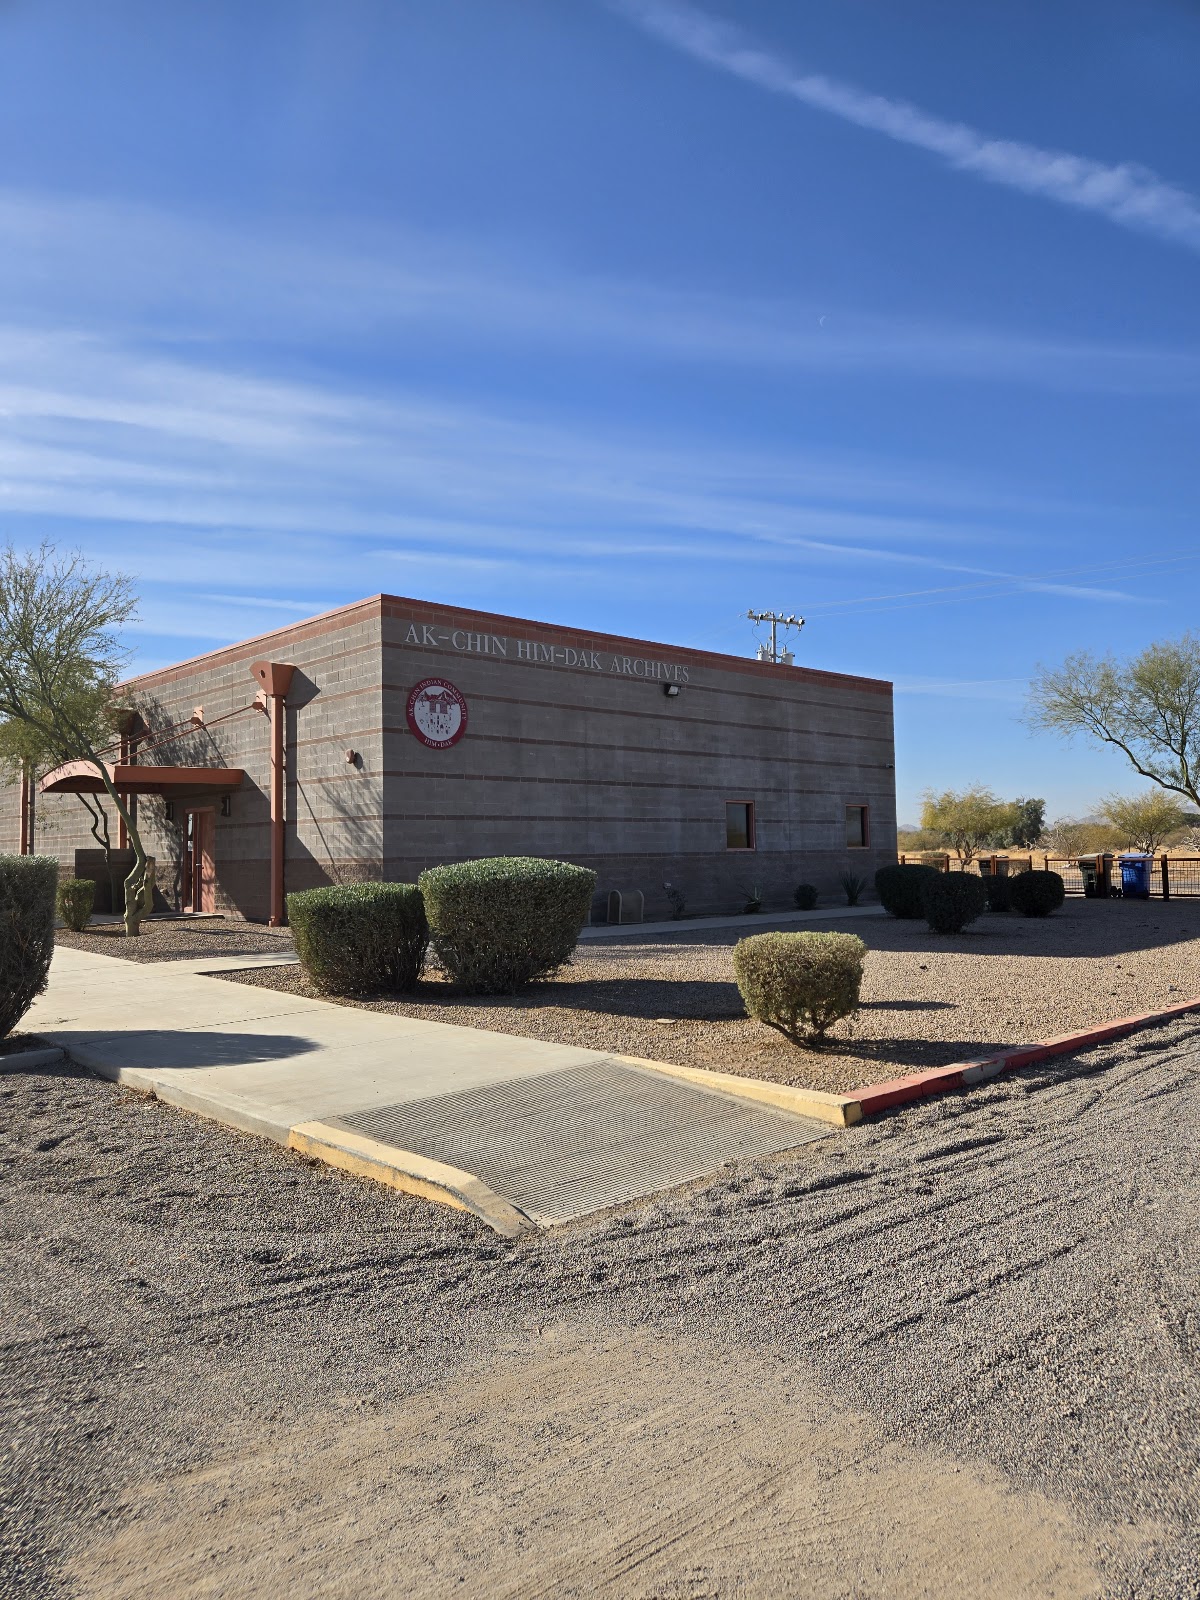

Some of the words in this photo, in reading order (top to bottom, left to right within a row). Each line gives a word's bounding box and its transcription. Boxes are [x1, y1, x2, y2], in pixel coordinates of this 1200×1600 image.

[404, 623, 507, 656] AK-CHIN
[517, 640, 603, 670] HIM-DAK
[610, 655, 690, 683] ARCHIVES
[420, 680, 441, 689] INDIAN
[444, 682, 467, 720] COMMUNITY
